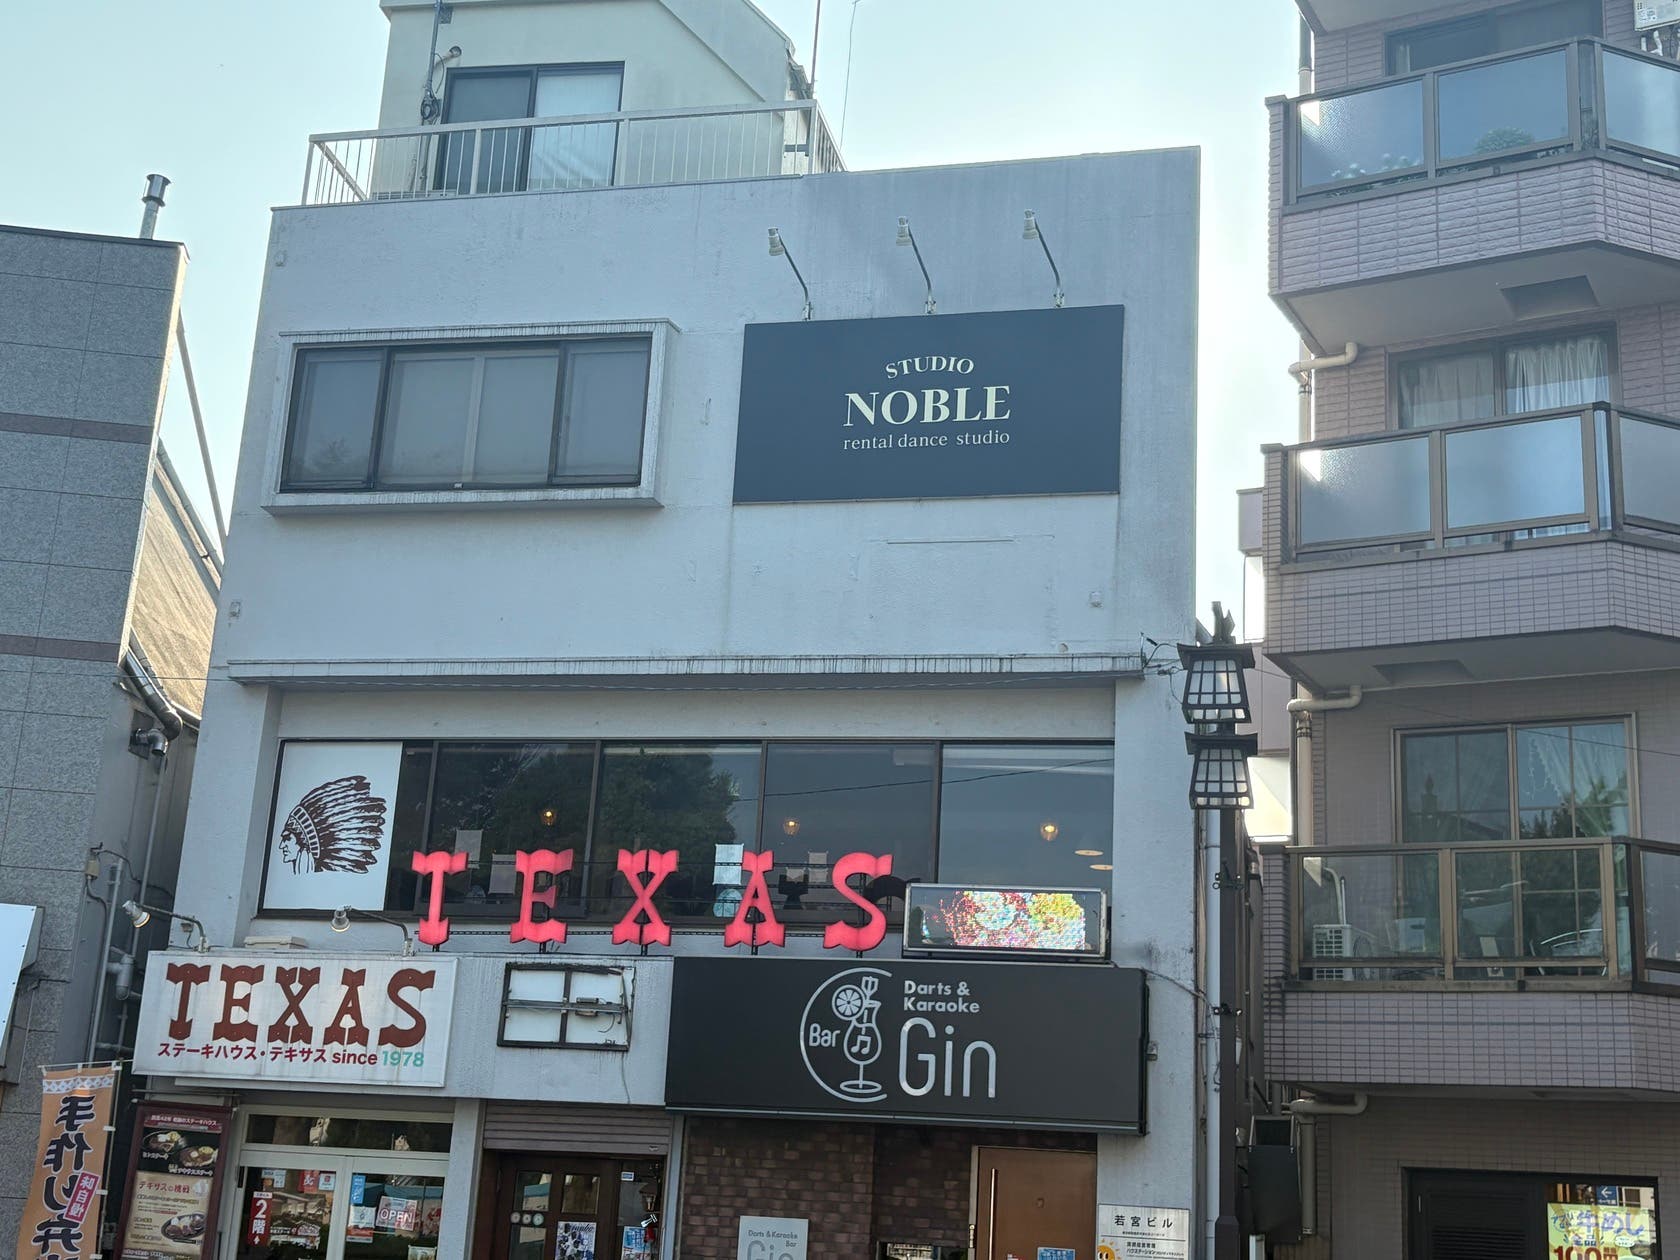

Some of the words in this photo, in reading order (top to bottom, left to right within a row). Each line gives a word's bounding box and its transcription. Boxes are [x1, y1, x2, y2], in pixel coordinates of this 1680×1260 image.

[885, 355, 975, 379] STUDIO
[842, 385, 1011, 427] NOBLE
[843, 434, 893, 451] rental
[897, 433, 948, 448] dance
[956, 430, 1010, 446] studio
[411, 848, 894, 951] TEXAS
[904, 980, 952, 996] Darts
[956, 981, 971, 996] &
[165, 962, 436, 1048] TEXAS
[903, 997, 980, 1013] Karaoke
[808, 1023, 841, 1048] Bar
[157, 1042, 327, 1064] ステーキハウス・テキサス
[331, 1050, 378, 1066] since
[381, 1050, 425, 1068] 1978
[899, 1017, 997, 1098] Gin
[380, 1208, 413, 1223] OPEN
[1114, 1215, 1173, 1229] 若宮ビル
